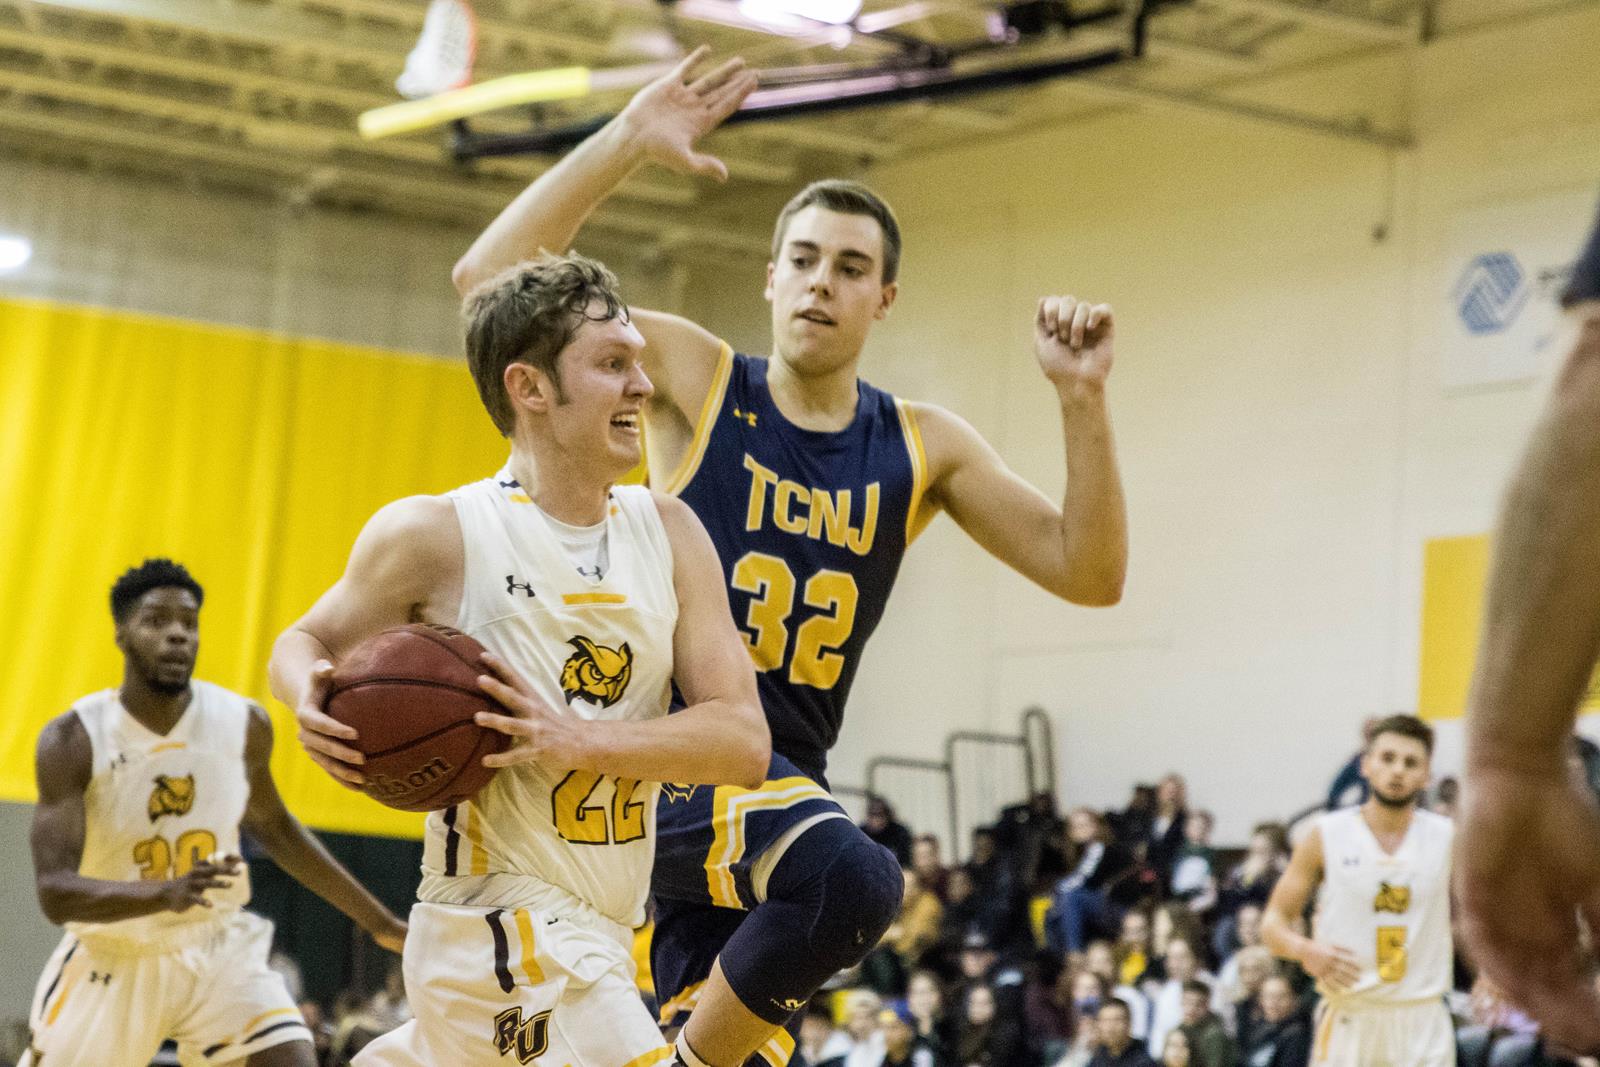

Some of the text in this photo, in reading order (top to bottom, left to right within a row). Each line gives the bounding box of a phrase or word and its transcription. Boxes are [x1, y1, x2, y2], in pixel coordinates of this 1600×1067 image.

[743, 452, 880, 556] TCNJ
[731, 550, 859, 690] 32
[1376, 926, 1408, 984] 5
[493, 1006, 553, 1066] RU
